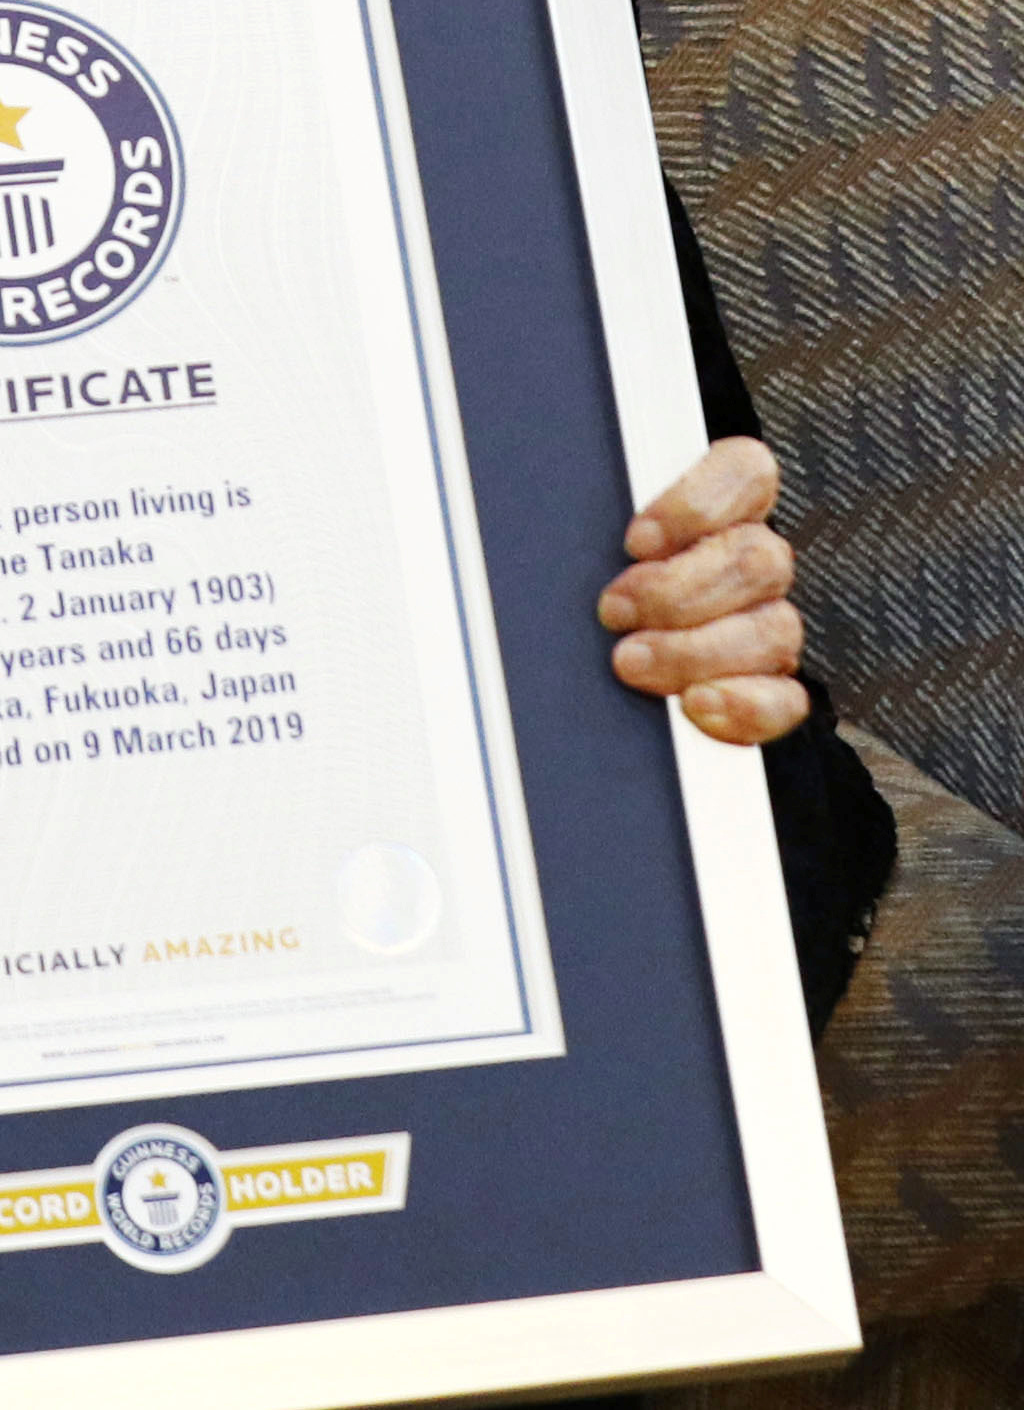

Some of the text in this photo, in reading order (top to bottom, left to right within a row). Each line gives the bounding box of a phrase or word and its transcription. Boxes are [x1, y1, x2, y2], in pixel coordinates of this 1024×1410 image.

[1, 136, 164, 328] RECORDS
[13, 497, 121, 535] person
[130, 483, 215, 518] living
[224, 480, 252, 508] is
[36, 537, 156, 573] Tanaka
[18, 593, 37, 622] 2
[49, 587, 176, 619] January
[188, 572, 276, 606] 1903)
[0, 643, 86, 678] years
[99, 629, 155, 662] and
[165, 625, 204, 656] 66
[215, 621, 289, 654] days
[43, 677, 189, 715] Fukuoka,
[200, 670, 297, 703] Japan
[34, 738, 72, 764] on
[82, 730, 102, 759] 9
[111, 719, 216, 756] March
[227, 710, 304, 746] 2019
[142, 928, 302, 964] AMAZING
[112, 1141, 201, 1181] GUINNESS
[230, 1161, 374, 1204] HOLDER
[107, 1182, 216, 1251] WORLD RECORDS
